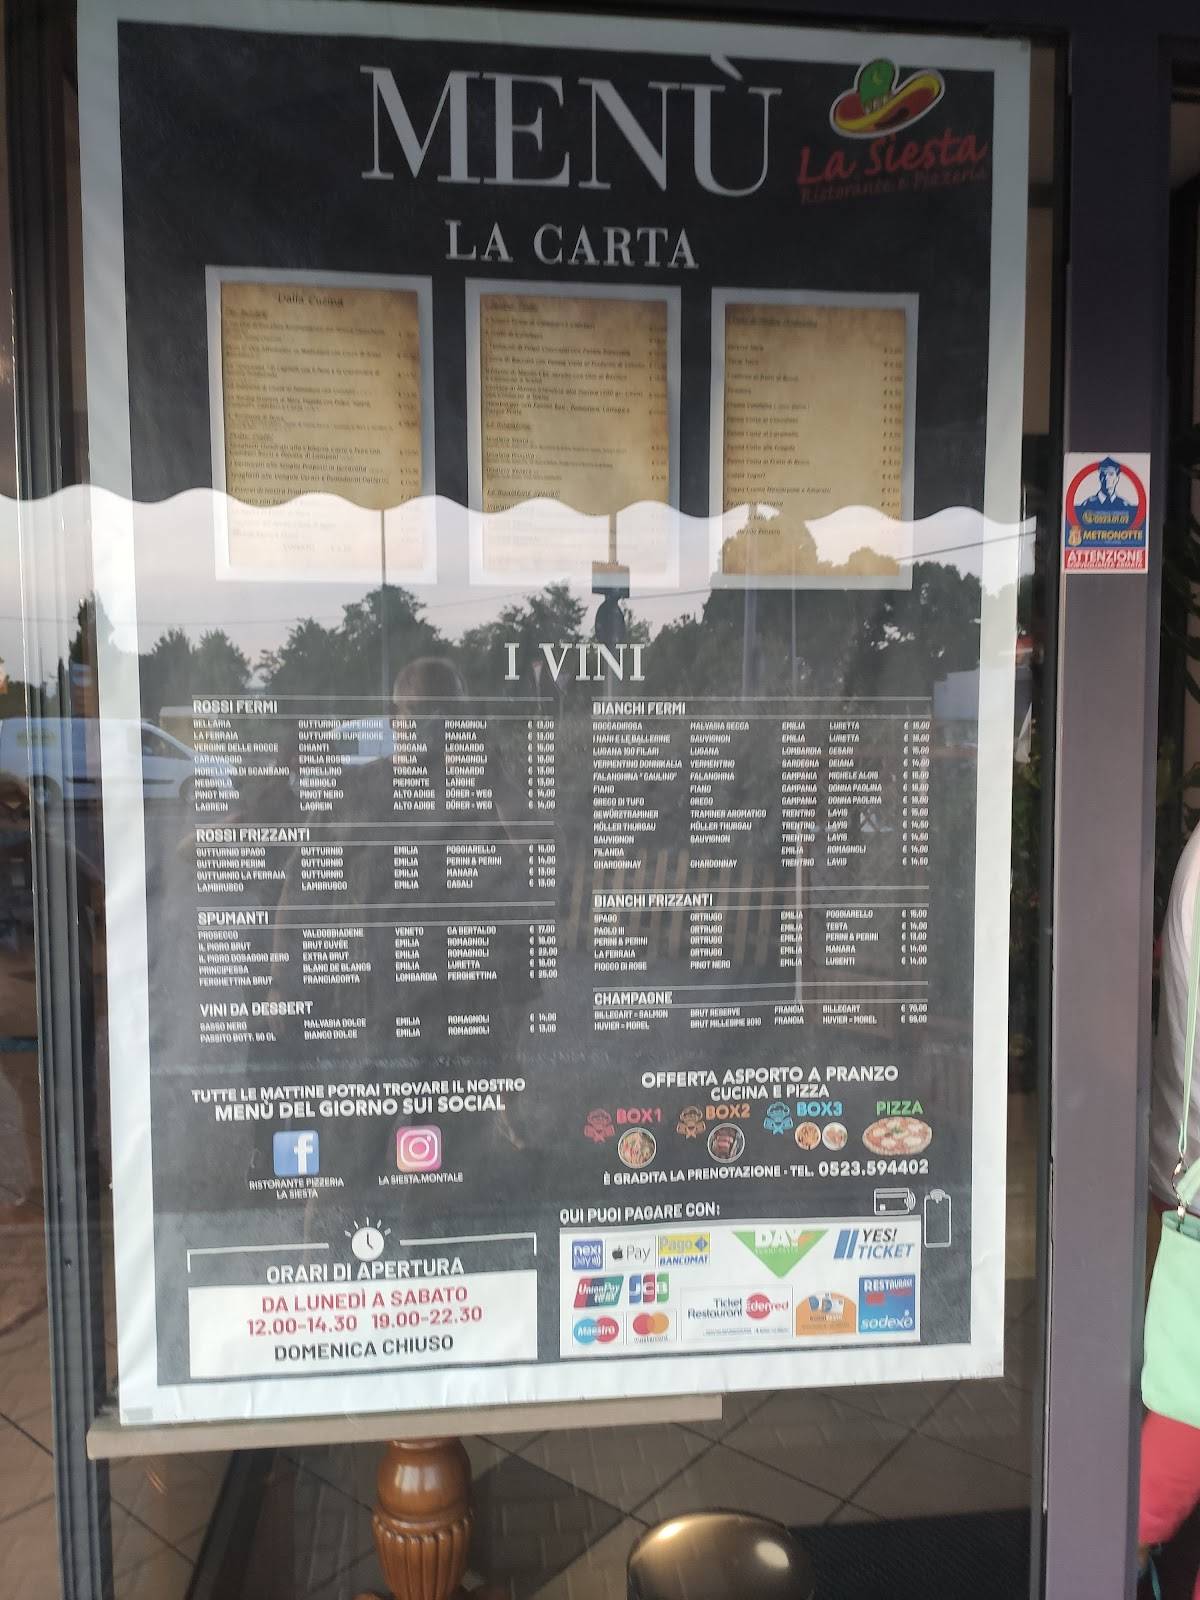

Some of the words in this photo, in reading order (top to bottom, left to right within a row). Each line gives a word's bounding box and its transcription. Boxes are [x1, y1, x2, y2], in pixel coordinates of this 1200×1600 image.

[360, 53, 782, 197] MENÙ
[797, 144, 857, 185] La
[864, 128, 990, 176] Siesta
[444, 219, 513, 262] LA
[534, 224, 699, 270] CARTA
[1083, 530, 1143, 540] METRONOTTE
[1068, 550, 1143, 561] ATTENZIONE
[504, 642, 520, 680] I
[538, 643, 645, 682] VINI
[192, 700, 233, 713] ROSSI
[237, 700, 278, 713] FERMI
[592, 702, 644, 715] BIANCHI
[648, 702, 686, 715] FERMI
[445, 743, 484, 752] LEONARDO
[445, 766, 484, 775] LEONARDO
[324, 790, 344, 799] NERO
[196, 828, 236, 842] ROSSI
[240, 828, 310, 842] FRIZZANTI
[594, 895, 645, 908] BIANCHI
[649, 893, 713, 907] FRIZZANTI
[198, 911, 269, 925] SPUMANTI
[594, 991, 673, 1005] CHAMPAGNE
[200, 1003, 227, 1017] VINI
[230, 1003, 248, 1016] DA
[252, 1001, 313, 1016] DESSERT
[641, 1071, 718, 1089] OFFERTA
[723, 1068, 804, 1085] ASPORTO
[808, 1068, 821, 1083] A
[826, 1066, 899, 1082] PRANZO
[191, 1089, 236, 1103] TUTTE
[240, 1088, 257, 1101] LE
[260, 1085, 325, 1101] MATTINE
[328, 1083, 380, 1098] POTRAI
[383, 1081, 449, 1096] TROVARE
[453, 1080, 465, 1094] IL
[469, 1078, 526, 1093] NOSTRO
[711, 1084, 768, 1101] CUCINA
[773, 1084, 781, 1098] E
[787, 1083, 830, 1099] PIZZA
[215, 1100, 274, 1121] MENÙ
[279, 1102, 316, 1119] DEL
[319, 1099, 398, 1118] GIORNO
[402, 1098, 433, 1114] SUI
[437, 1094, 506, 1113] SOCIAL
[706, 1104, 751, 1120] BOX2
[796, 1101, 843, 1117] BOX3
[876, 1100, 924, 1115] PIZZA
[616, 1107, 662, 1124] BOX1
[603, 1170, 611, 1185] È
[613, 1170, 668, 1184] GRADITA
[670, 1170, 686, 1182] LA
[687, 1164, 781, 1181] PRENOTAZIONE
[790, 1165, 814, 1177] TEL.
[818, 1159, 929, 1177] 0523.594402
[249, 1179, 304, 1191] RISTORANTE
[378, 1175, 390, 1185] LA
[276, 1191, 288, 1200] LA
[290, 1189, 319, 1199] SIESTA
[560, 1208, 585, 1225] QUI
[587, 1207, 621, 1223] PUOI
[624, 1204, 683, 1222] PAGARE
[685, 1202, 721, 1218] CON:
[862, 1228, 898, 1242] YES!
[573, 1244, 602, 1254] nexi
[660, 1235, 692, 1254] Pago
[858, 1243, 915, 1259] TICKET
[626, 1244, 651, 1263] Pay
[660, 1255, 708, 1266] BANCOMAT
[266, 1263, 329, 1284] ORARI
[333, 1262, 351, 1281] DI
[357, 1257, 465, 1281] APERTURA
[578, 1282, 620, 1295] UnionPay
[262, 1296, 289, 1314] DA
[294, 1291, 367, 1312] LUNEDÌ
[372, 1292, 385, 1308] A
[391, 1286, 468, 1307] SABATO
[712, 1297, 743, 1310] Ticket
[687, 1305, 743, 1320] Restaurant
[248, 1315, 358, 1336] 12.00-14.30
[372, 1306, 483, 1329] 19.00-22.30
[577, 1323, 615, 1337] Maestro
[274, 1339, 377, 1363] DOMENICA
[382, 1335, 454, 1357] CHIUSO
